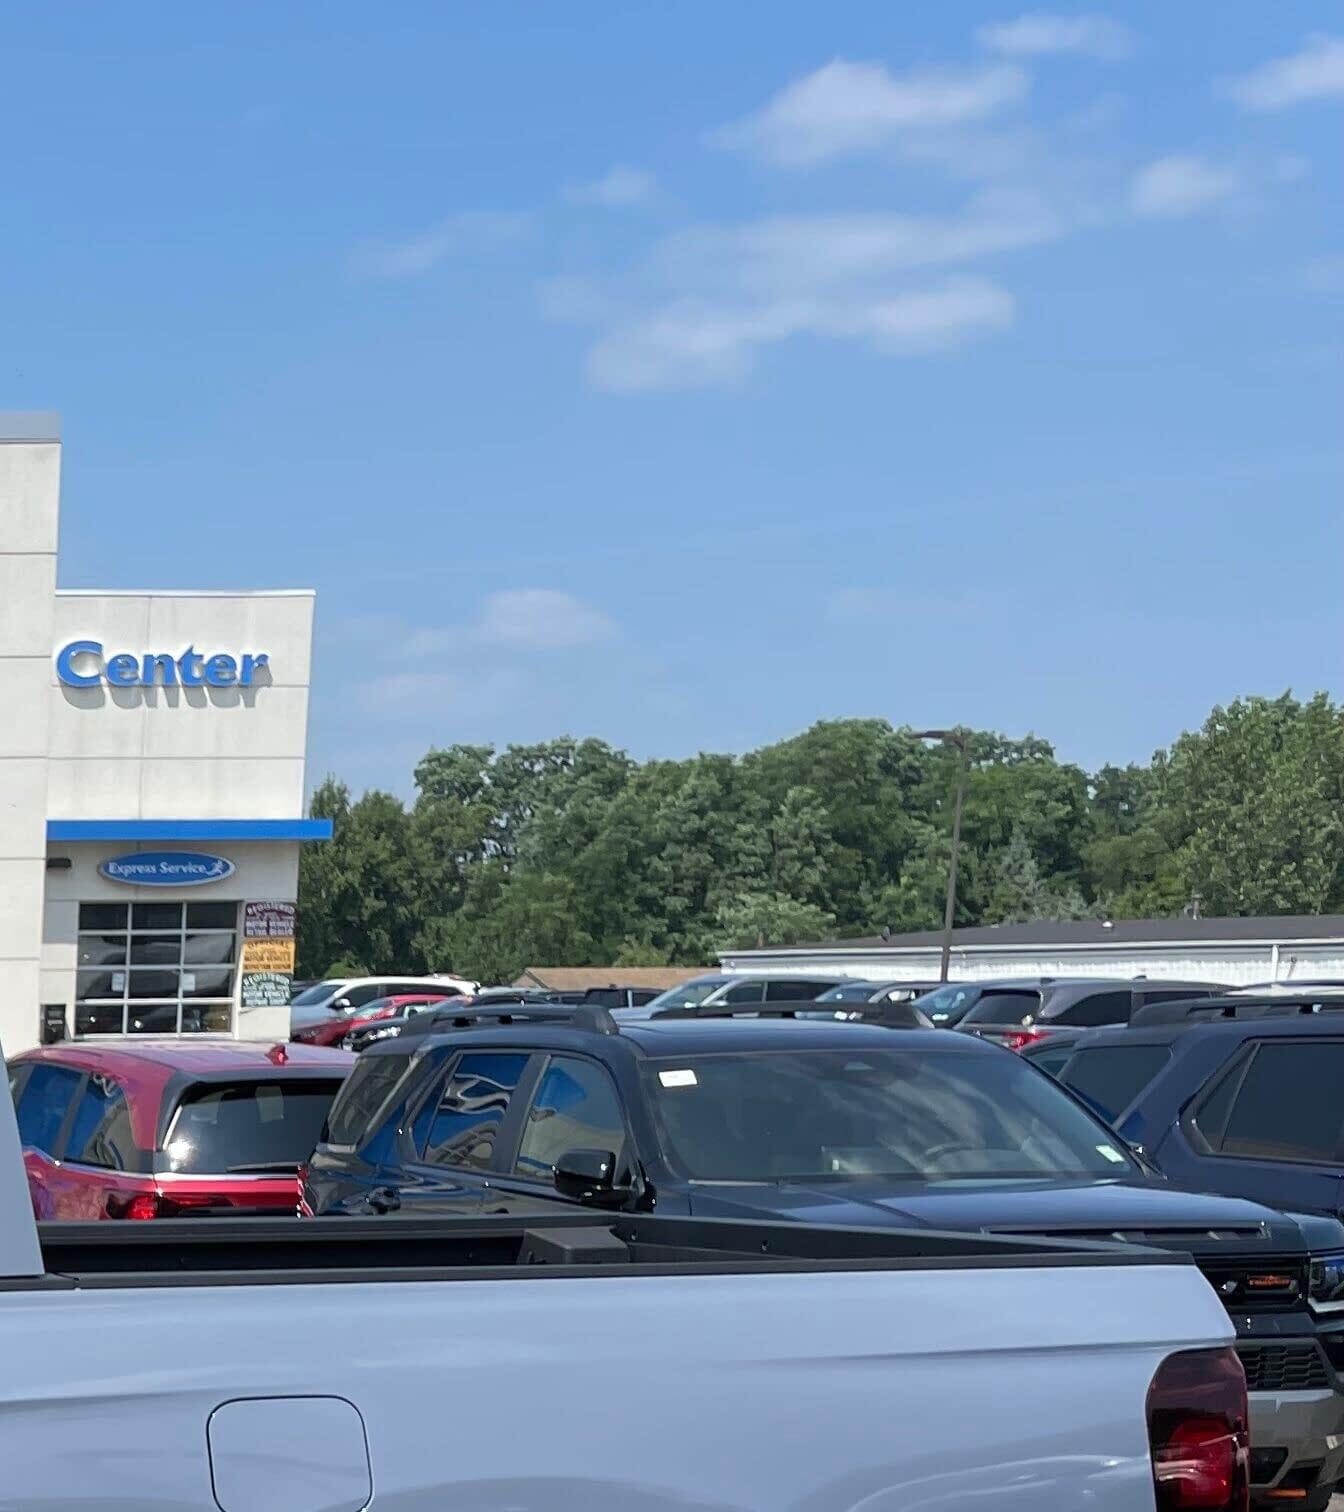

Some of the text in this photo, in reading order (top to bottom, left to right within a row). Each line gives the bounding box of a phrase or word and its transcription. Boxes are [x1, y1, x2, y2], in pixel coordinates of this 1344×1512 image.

[56, 640, 270, 688] Center
[108, 861, 208, 878] Express Service
